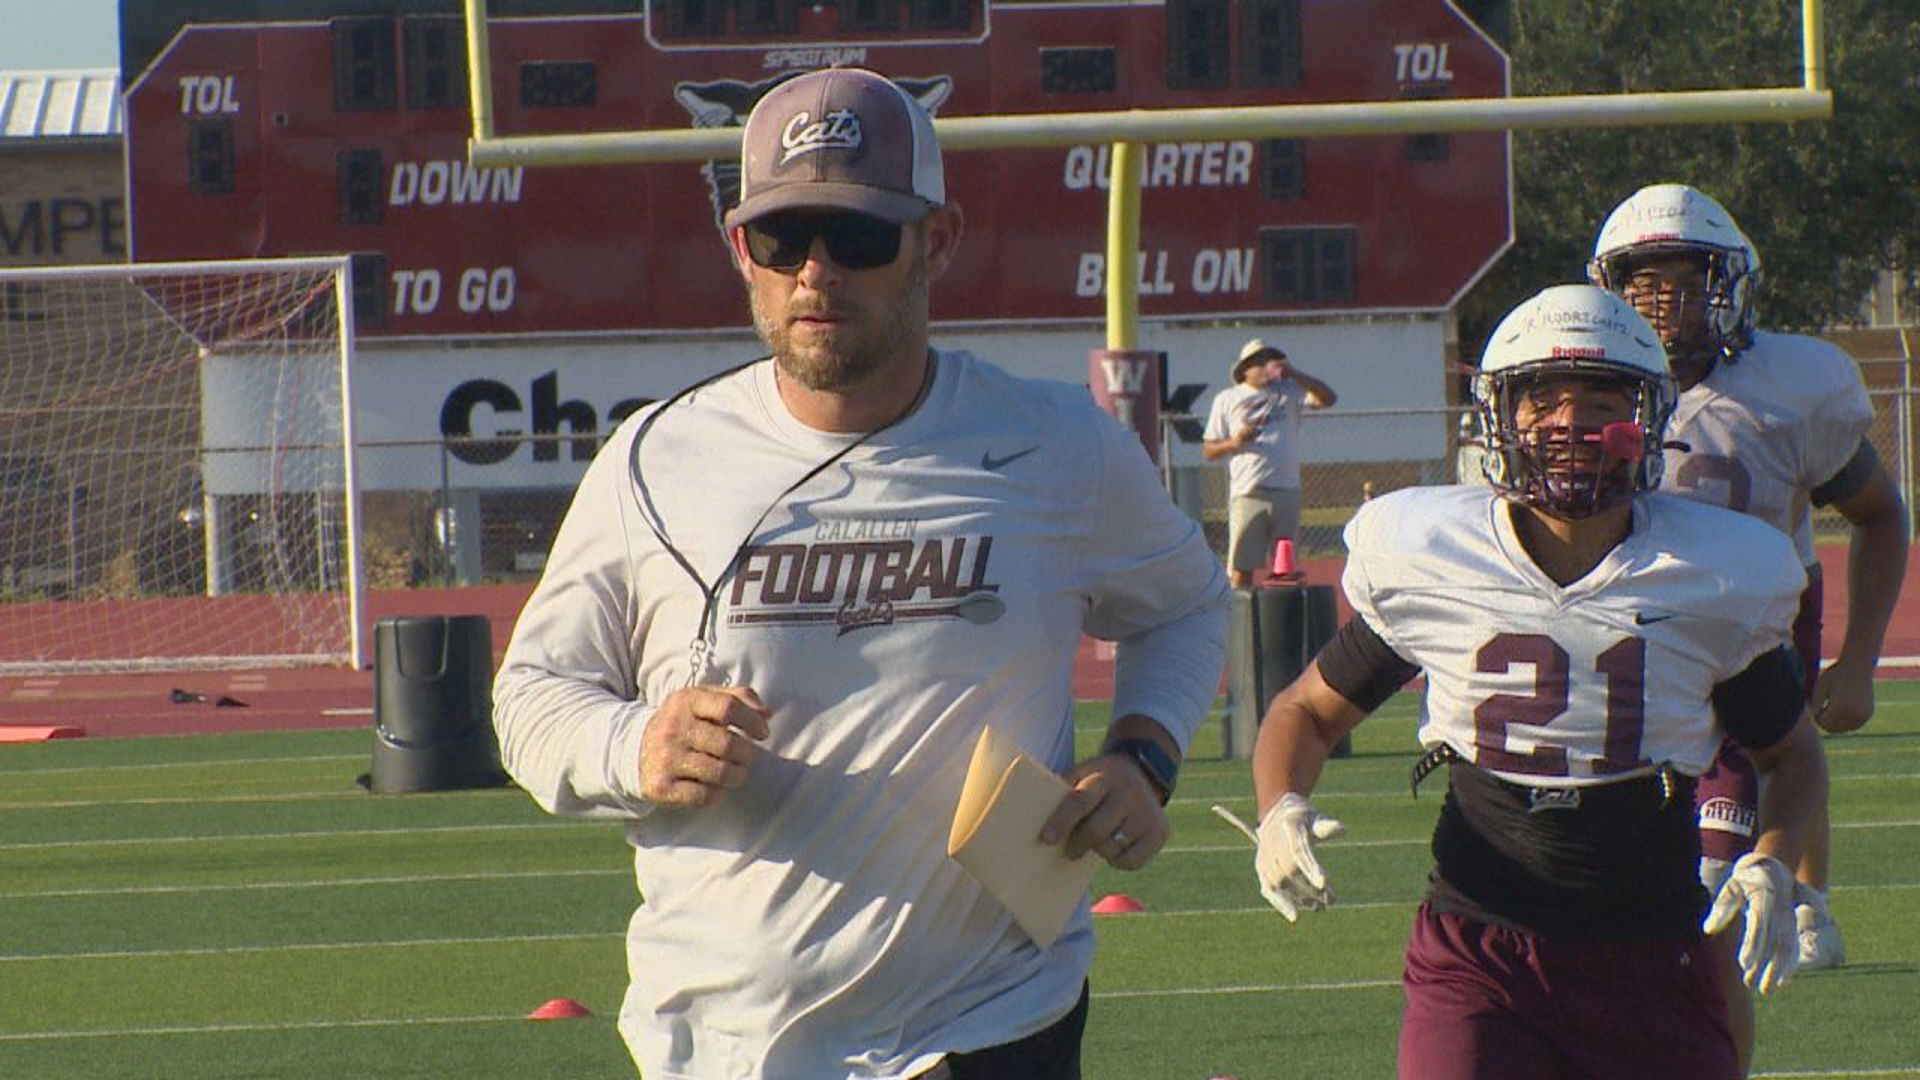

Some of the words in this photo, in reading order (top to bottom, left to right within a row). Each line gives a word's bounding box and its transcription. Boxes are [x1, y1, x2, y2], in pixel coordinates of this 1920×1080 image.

[762, 48, 866, 68] SPECTRUM
[1394, 44, 1455, 81] TOL
[179, 75, 240, 113] TOL
[779, 108, 862, 166] Cats
[389, 160, 524, 205] DOWN
[391, 268, 442, 315] TO
[457, 265, 516, 314] GO
[1075, 251, 1175, 297] BLL
[1192, 248, 1255, 293] ON
[813, 518, 919, 542] CALALLEN
[730, 535, 1001, 606] FOOTBALL
[1474, 632, 1646, 777] 21
